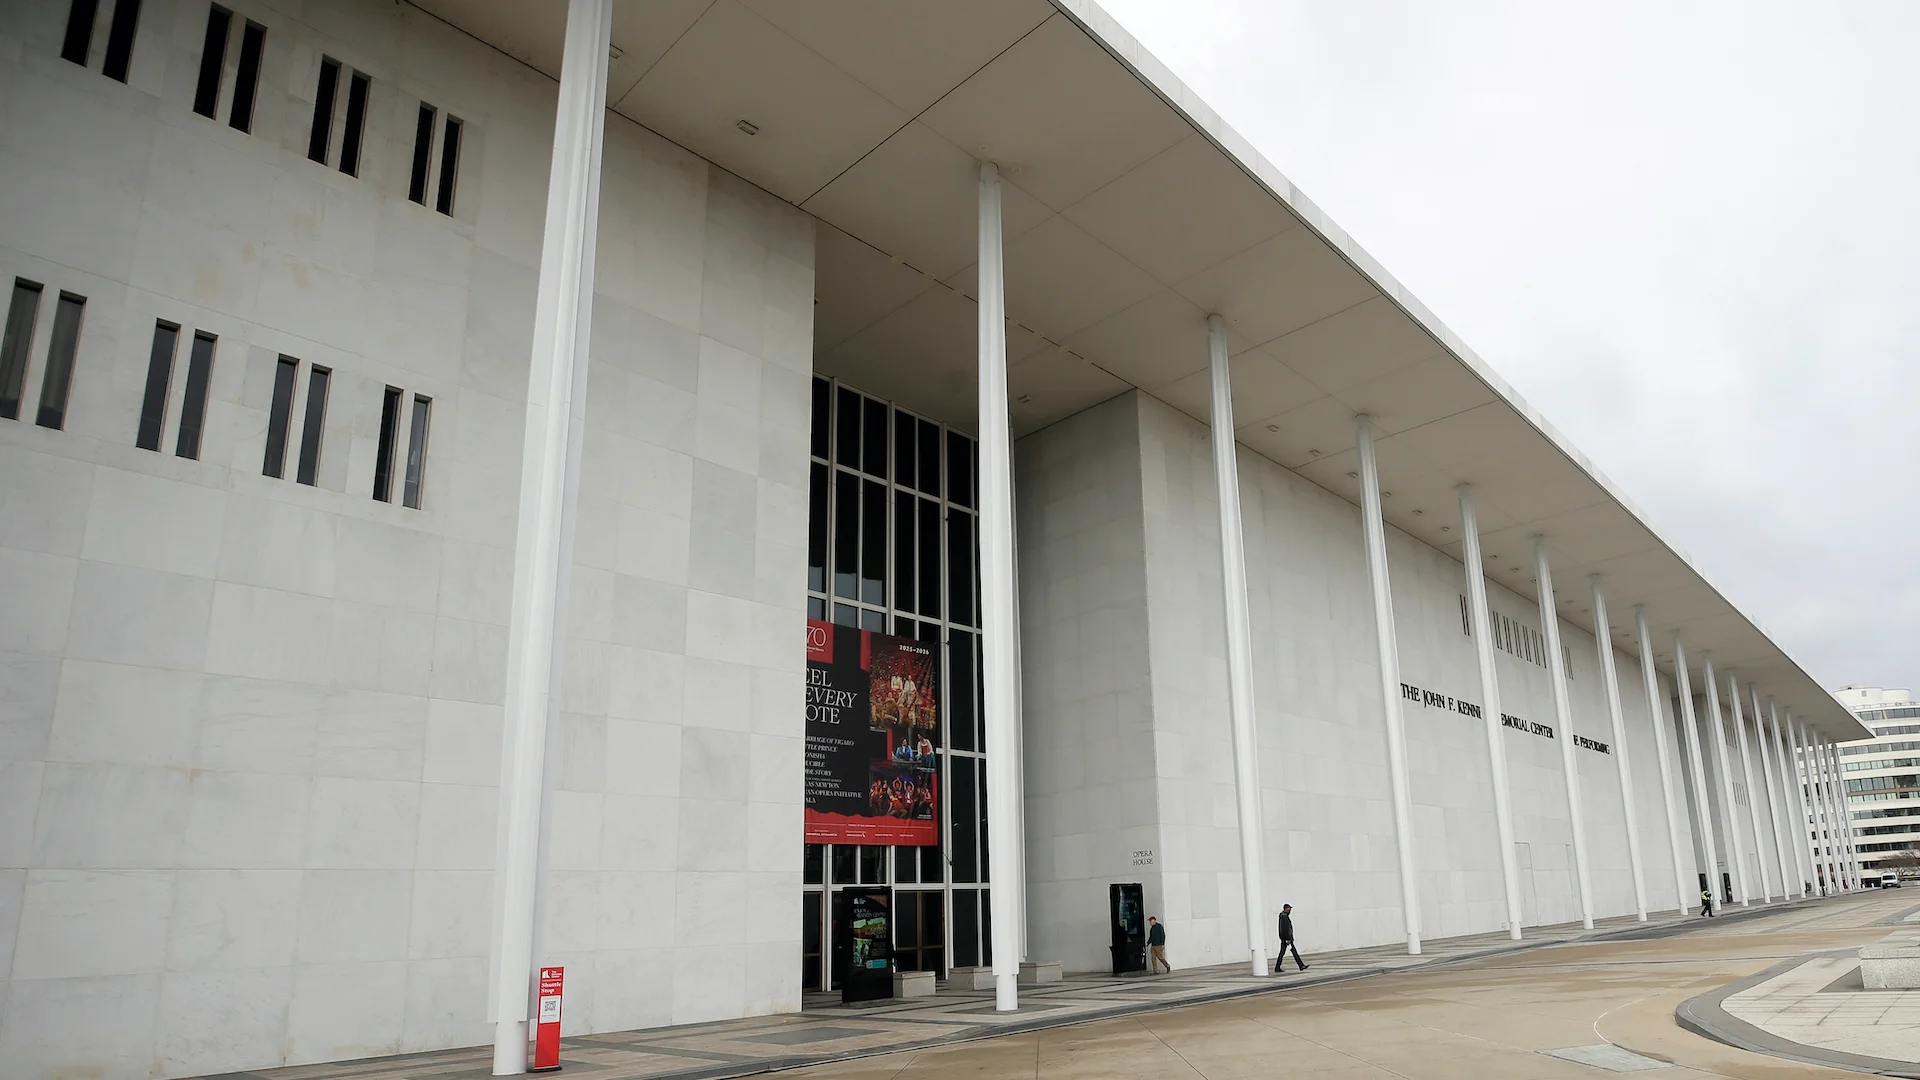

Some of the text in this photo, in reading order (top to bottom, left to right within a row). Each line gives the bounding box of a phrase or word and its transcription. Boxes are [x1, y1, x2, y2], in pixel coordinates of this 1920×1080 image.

[806, 626, 826, 646] 70
[806, 667, 832, 687] EL
[805, 685, 858, 709] EVERY
[805, 704, 841, 724] OTE
[1400, 682, 1420, 702] THE
[1422, 689, 1446, 708] JOHN
[1448, 697, 1456, 711] F.
[1457, 699, 1482, 720] KENN
[1500, 713, 1530, 732] EMORIAL
[1530, 721, 1554, 739] CENTER
[1579, 736, 1610, 755] PERFORMING
[805, 752, 826, 760] ONISHA
[805, 760, 826, 768] UCIBLE
[815, 789, 834, 797] OPERA
[1132, 850, 1153, 858] OPERA
[1132, 858, 1154, 866] HOUSE
